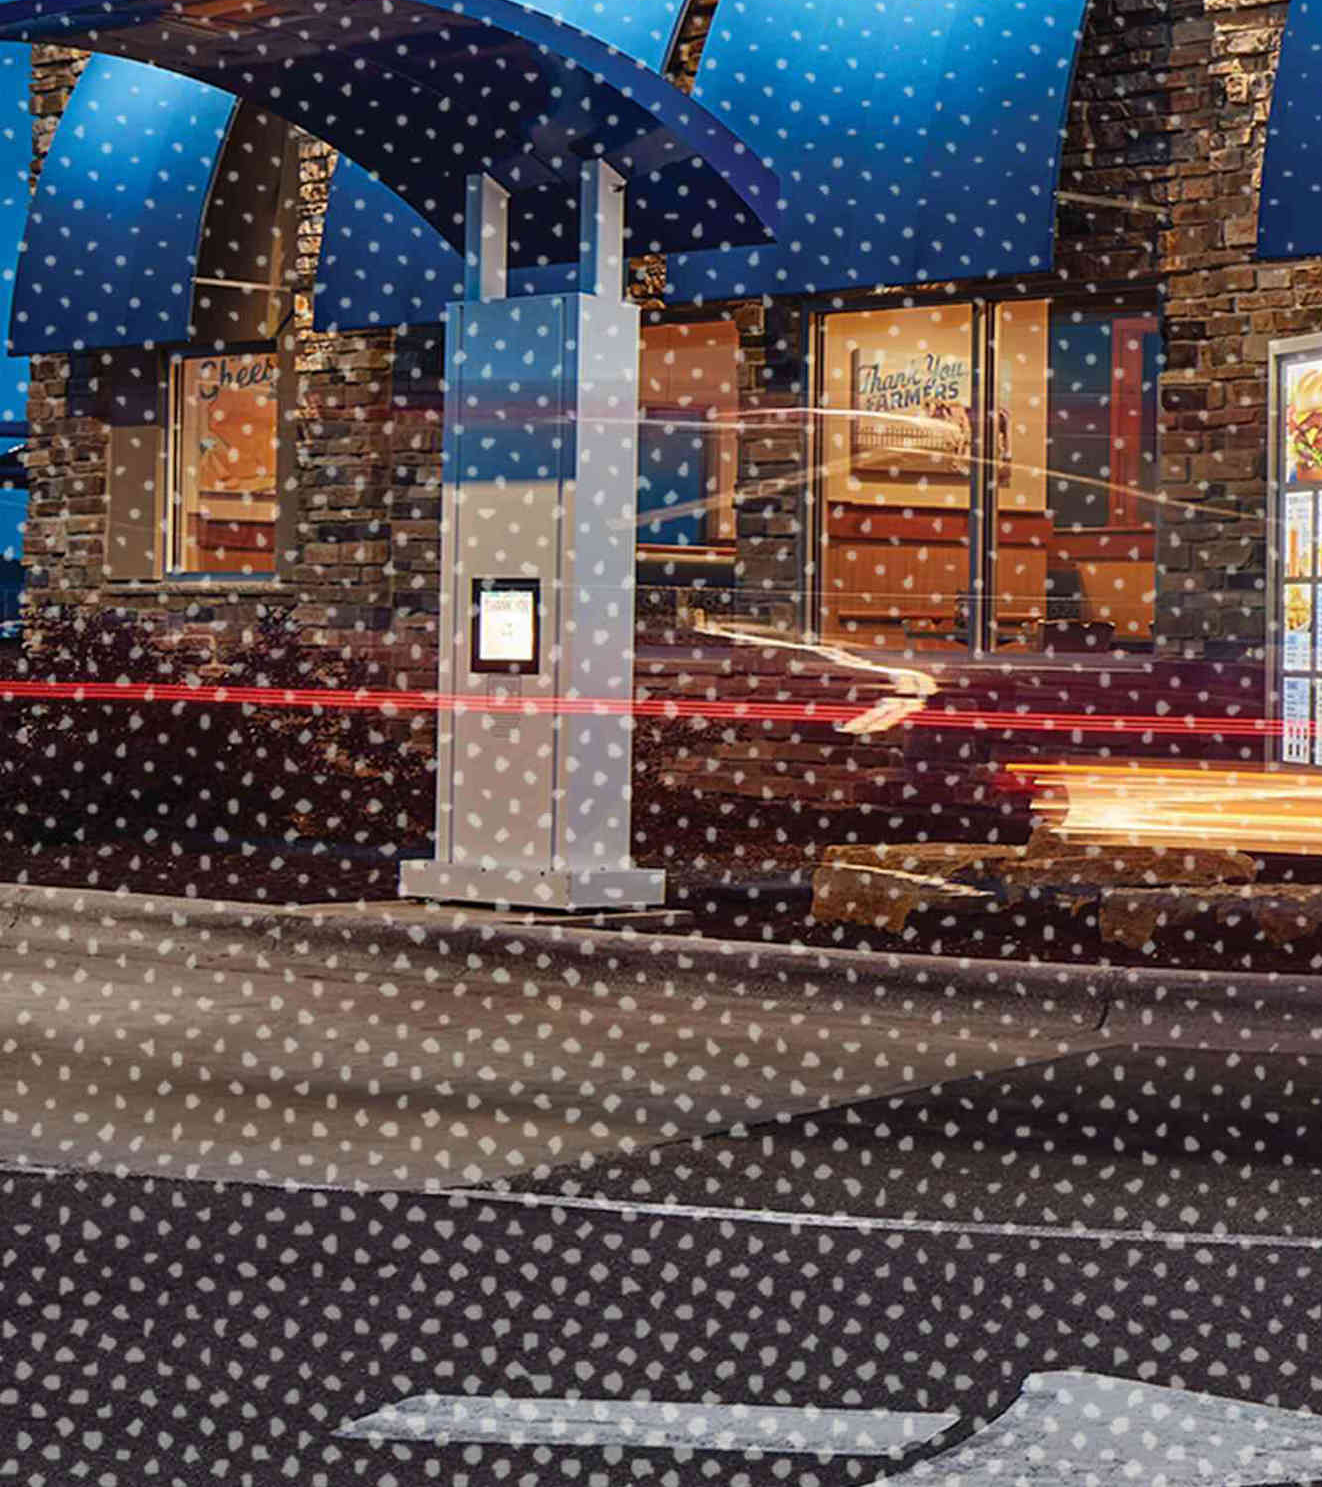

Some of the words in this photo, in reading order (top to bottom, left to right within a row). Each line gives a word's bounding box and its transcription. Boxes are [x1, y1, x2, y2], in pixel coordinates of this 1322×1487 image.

[857, 359, 922, 394] Thank
[924, 353, 967, 386] You
[864, 380, 960, 412] FARMERS
